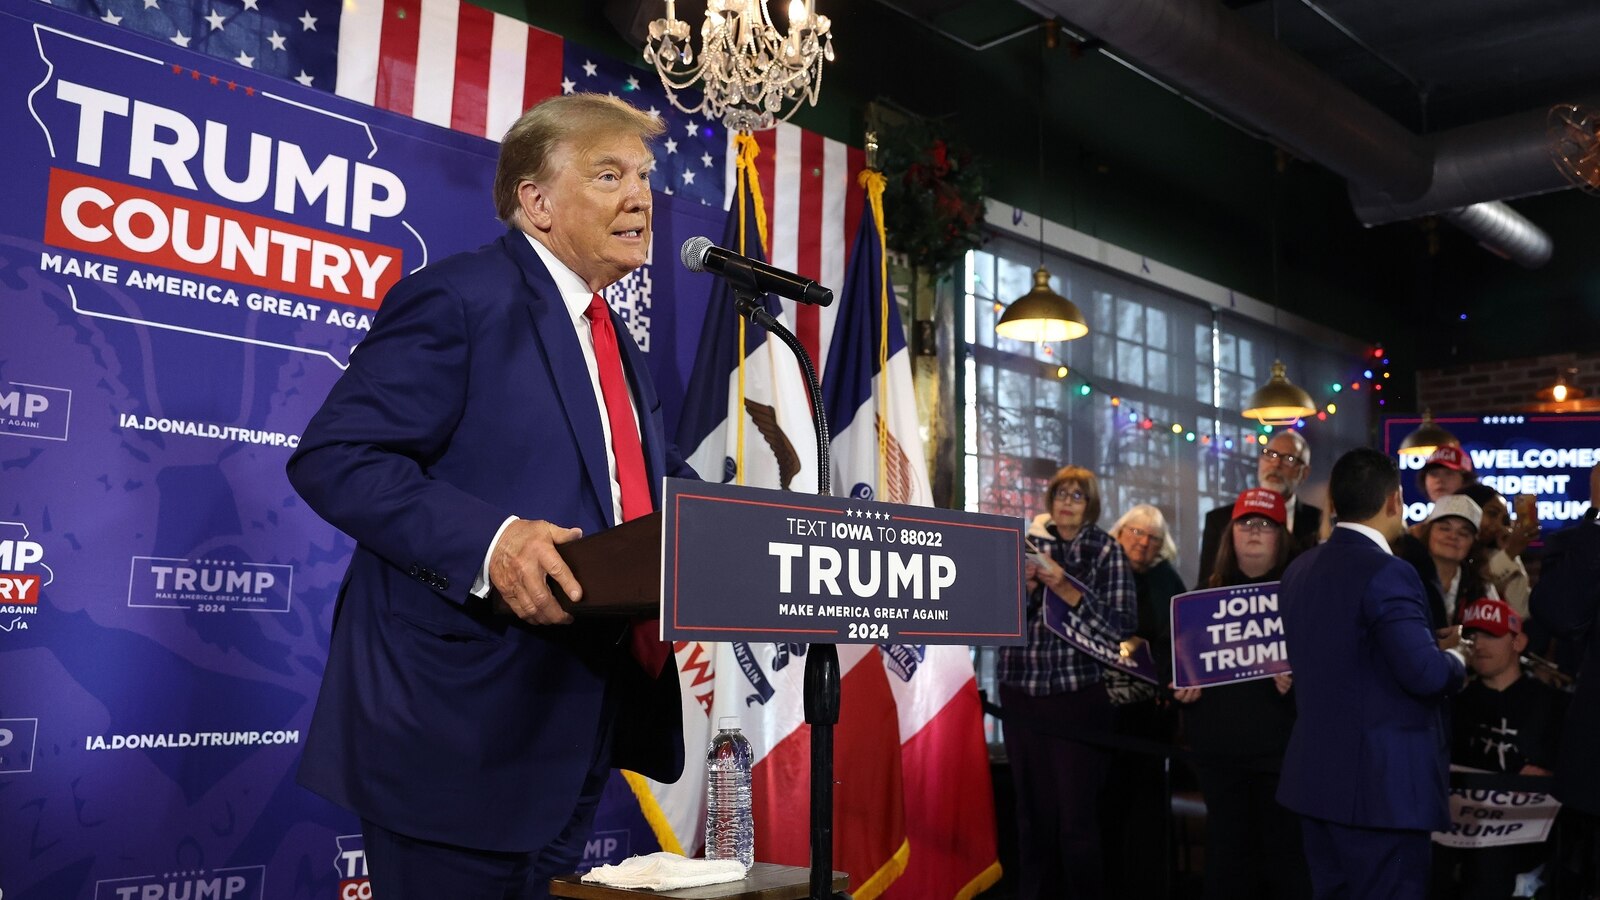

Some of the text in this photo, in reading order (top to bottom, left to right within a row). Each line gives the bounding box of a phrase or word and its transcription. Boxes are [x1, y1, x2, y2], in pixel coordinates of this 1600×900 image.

[57, 79, 407, 233] TRUMP
[60, 186, 393, 300] COUNTRY
[40, 252, 375, 332] MAKE AMERICA GREAT AGA
[8, 419, 40, 429] AGAIN!
[119, 413, 302, 449] IA.DONALDJTRUMP.C
[1477, 474, 1571, 495] SIDENT
[787, 517, 943, 547] TEXT IOWA TO 88022
[151, 566, 275, 594] TRUMP
[768, 541, 957, 600] TRUMP
[155, 592, 268, 604] MAKE AMERICA GREAT AGAIN!
[197, 604, 226, 613] 2024
[1212, 593, 1279, 619] JOIN
[0, 606, 38, 615] AGAIN!
[779, 603, 949, 621] MAKE AMERICA GREAT AGAIN!
[17, 621, 28, 630] IA
[848, 623, 889, 639] 2024
[1206, 616, 1285, 645] TEAM
[734, 642, 761, 684] INTAIN
[86, 730, 300, 750] IA.DONALDJTRUMP.COM
[1460, 805, 1505, 820] FOR
[1443, 822, 1523, 837] RUMP
